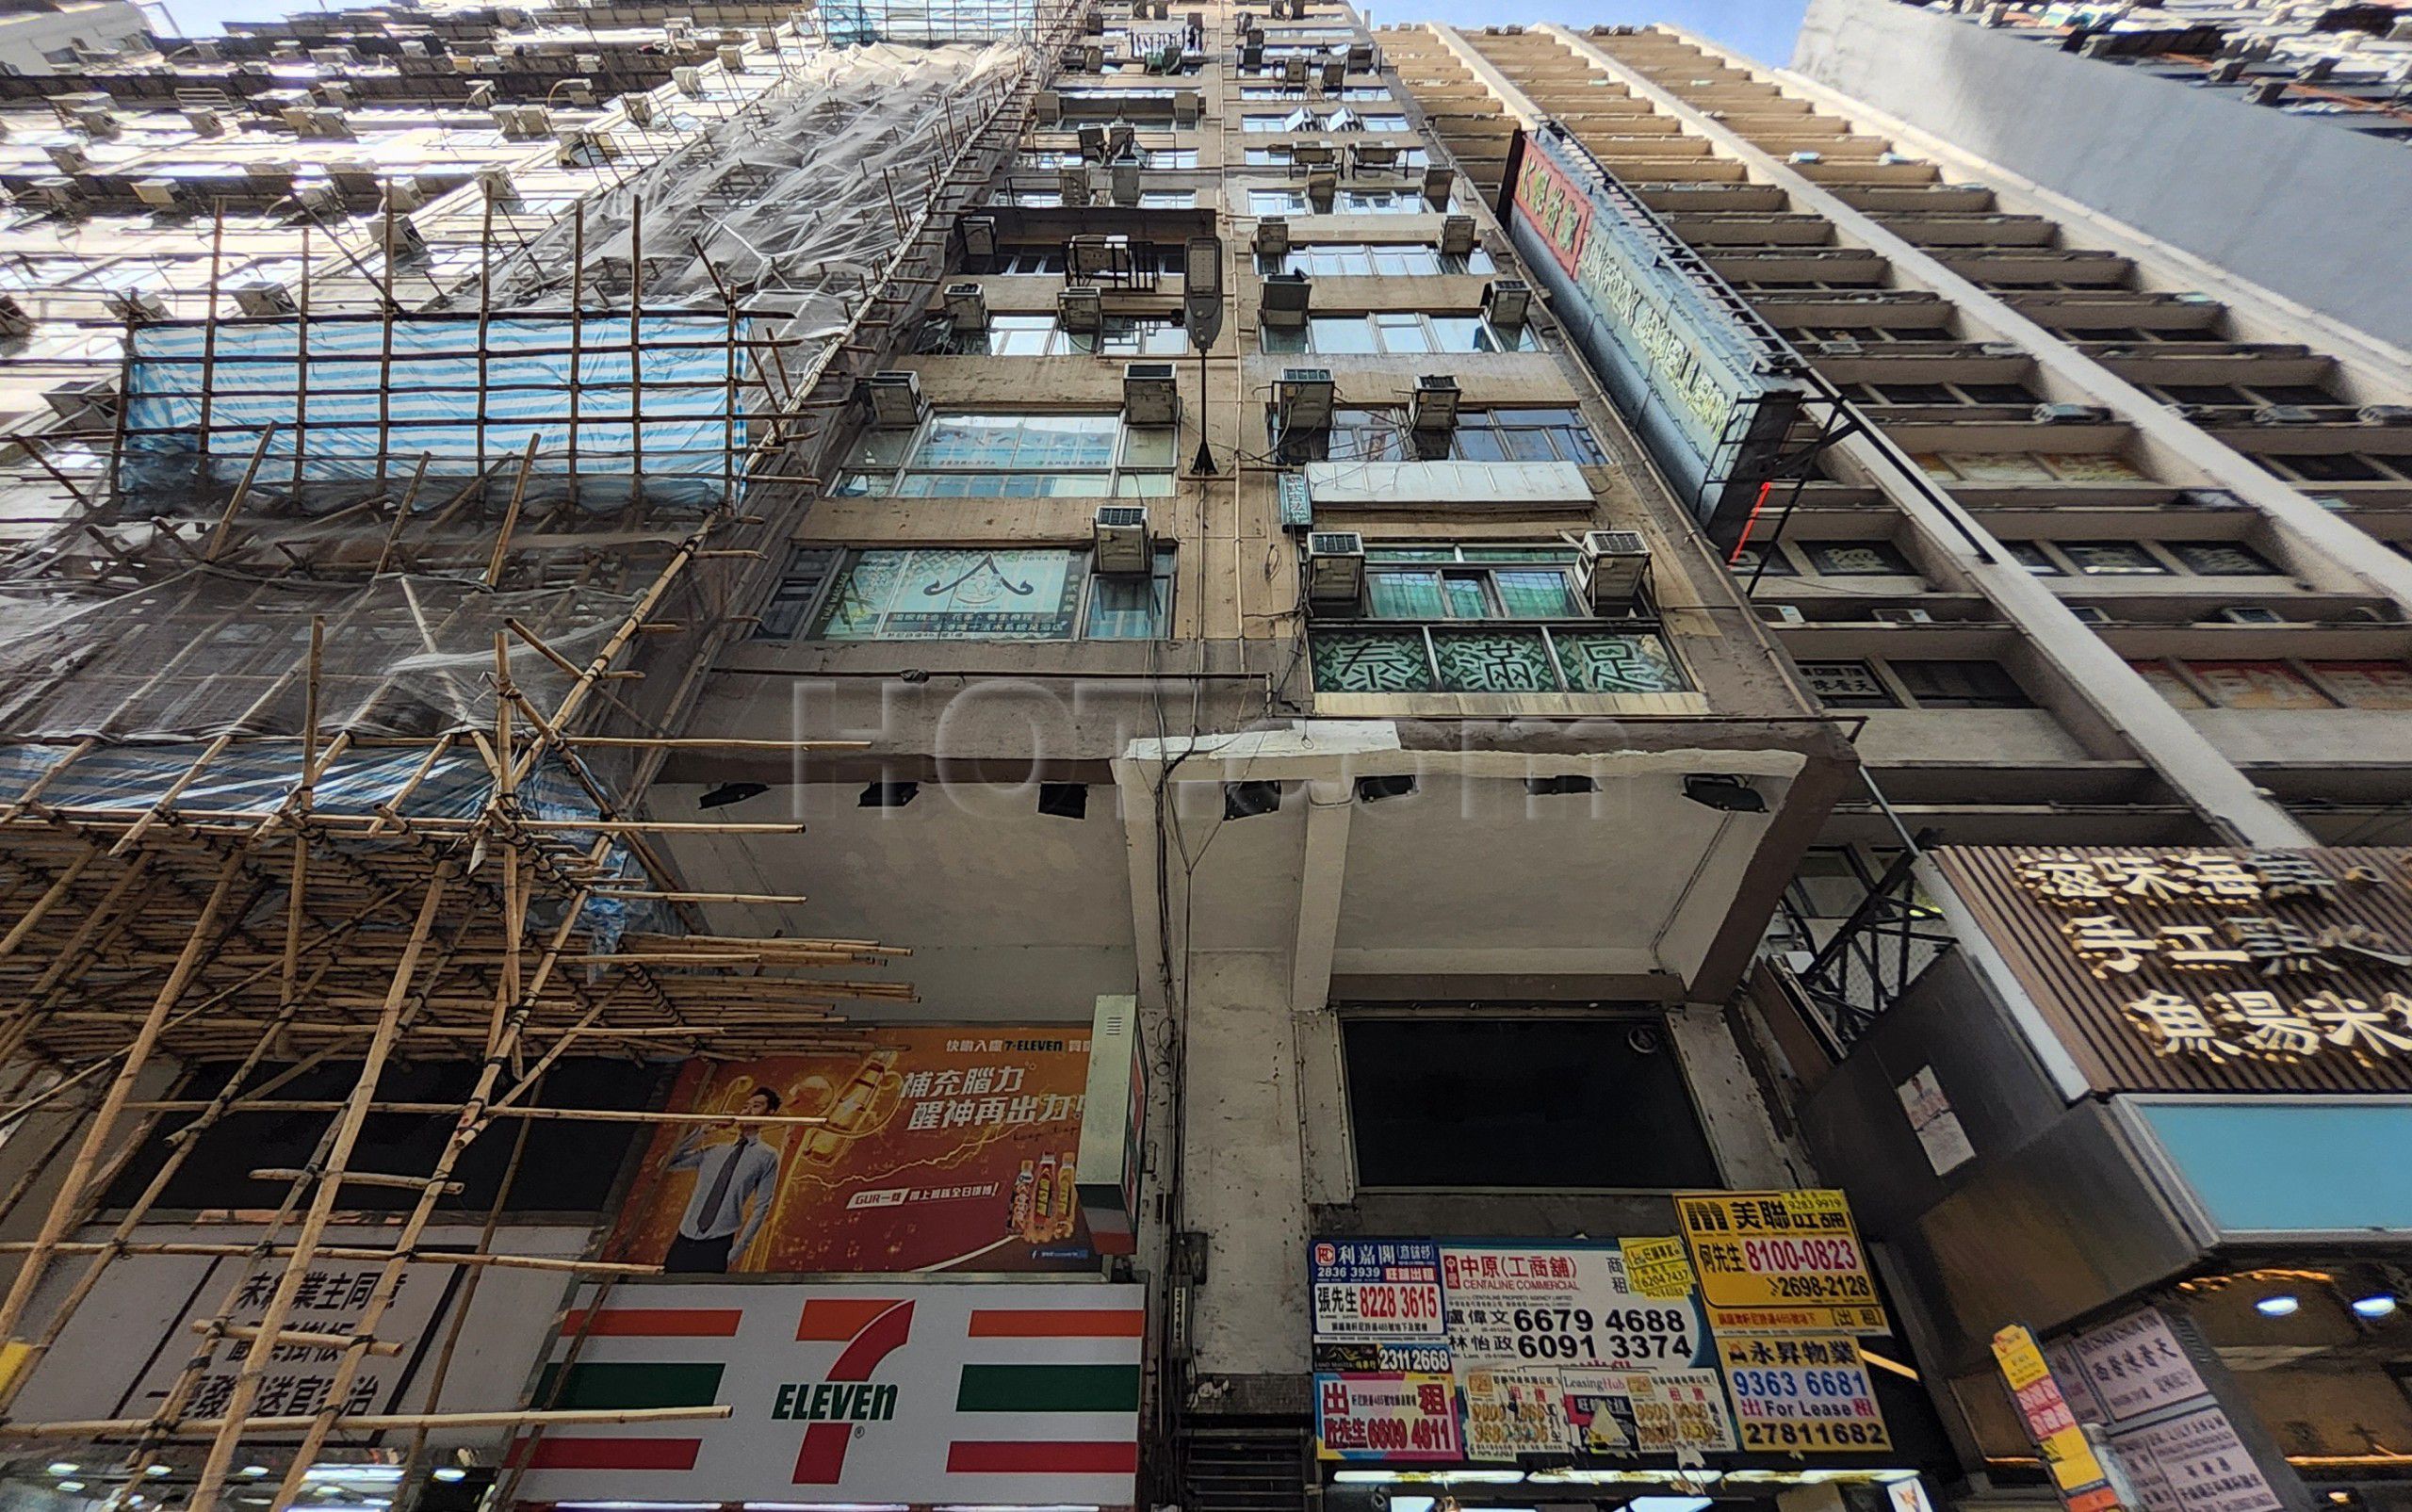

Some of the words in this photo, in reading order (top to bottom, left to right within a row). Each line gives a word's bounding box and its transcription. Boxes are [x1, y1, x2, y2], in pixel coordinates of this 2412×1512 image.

[1339, 641, 1663, 691] 泰滿足
[900, 1065, 1025, 1098] 補充腦力
[1460, 1255, 1578, 1279] 中原(工商舖)
[1745, 1239, 1857, 1272] 8100-0823
[1317, 1266, 1346, 1277] 2836
[1350, 1266, 1380, 1277] 3939
[1463, 1279, 1515, 1291] CENTALINE
[1516, 1279, 1580, 1291] COMMERCIAL
[1778, 1276, 1870, 1297] 2698-2128
[1317, 1286, 1359, 1312] 張先生
[1360, 1285, 1397, 1318] 8228
[1399, 1285, 1438, 1318] 3615
[1514, 1309, 1594, 1333] 6679
[1605, 1309, 1686, 1333] 4688
[1449, 1335, 1514, 1351] 林怡政
[1518, 1335, 1596, 1358] 6091
[1609, 1335, 1692, 1358] 3374
[1750, 1341, 1857, 1365] 永昇物業
[1378, 1348, 1411, 1371] 2311
[1412, 1348, 1450, 1371] 2668
[791, 1299, 916, 1485] 7
[1734, 1370, 1798, 1396] 9363
[1805, 1370, 1867, 1396] 6681
[1324, 1382, 1349, 1415] 出
[1417, 1384, 1448, 1415] 租
[1765, 1400, 1795, 1417] For
[1799, 1400, 1851, 1417] Lease
[1368, 1418, 1408, 1450] 6609
[1411, 1418, 1451, 1450] 4811
[1745, 1422, 1887, 1445] 27811682
